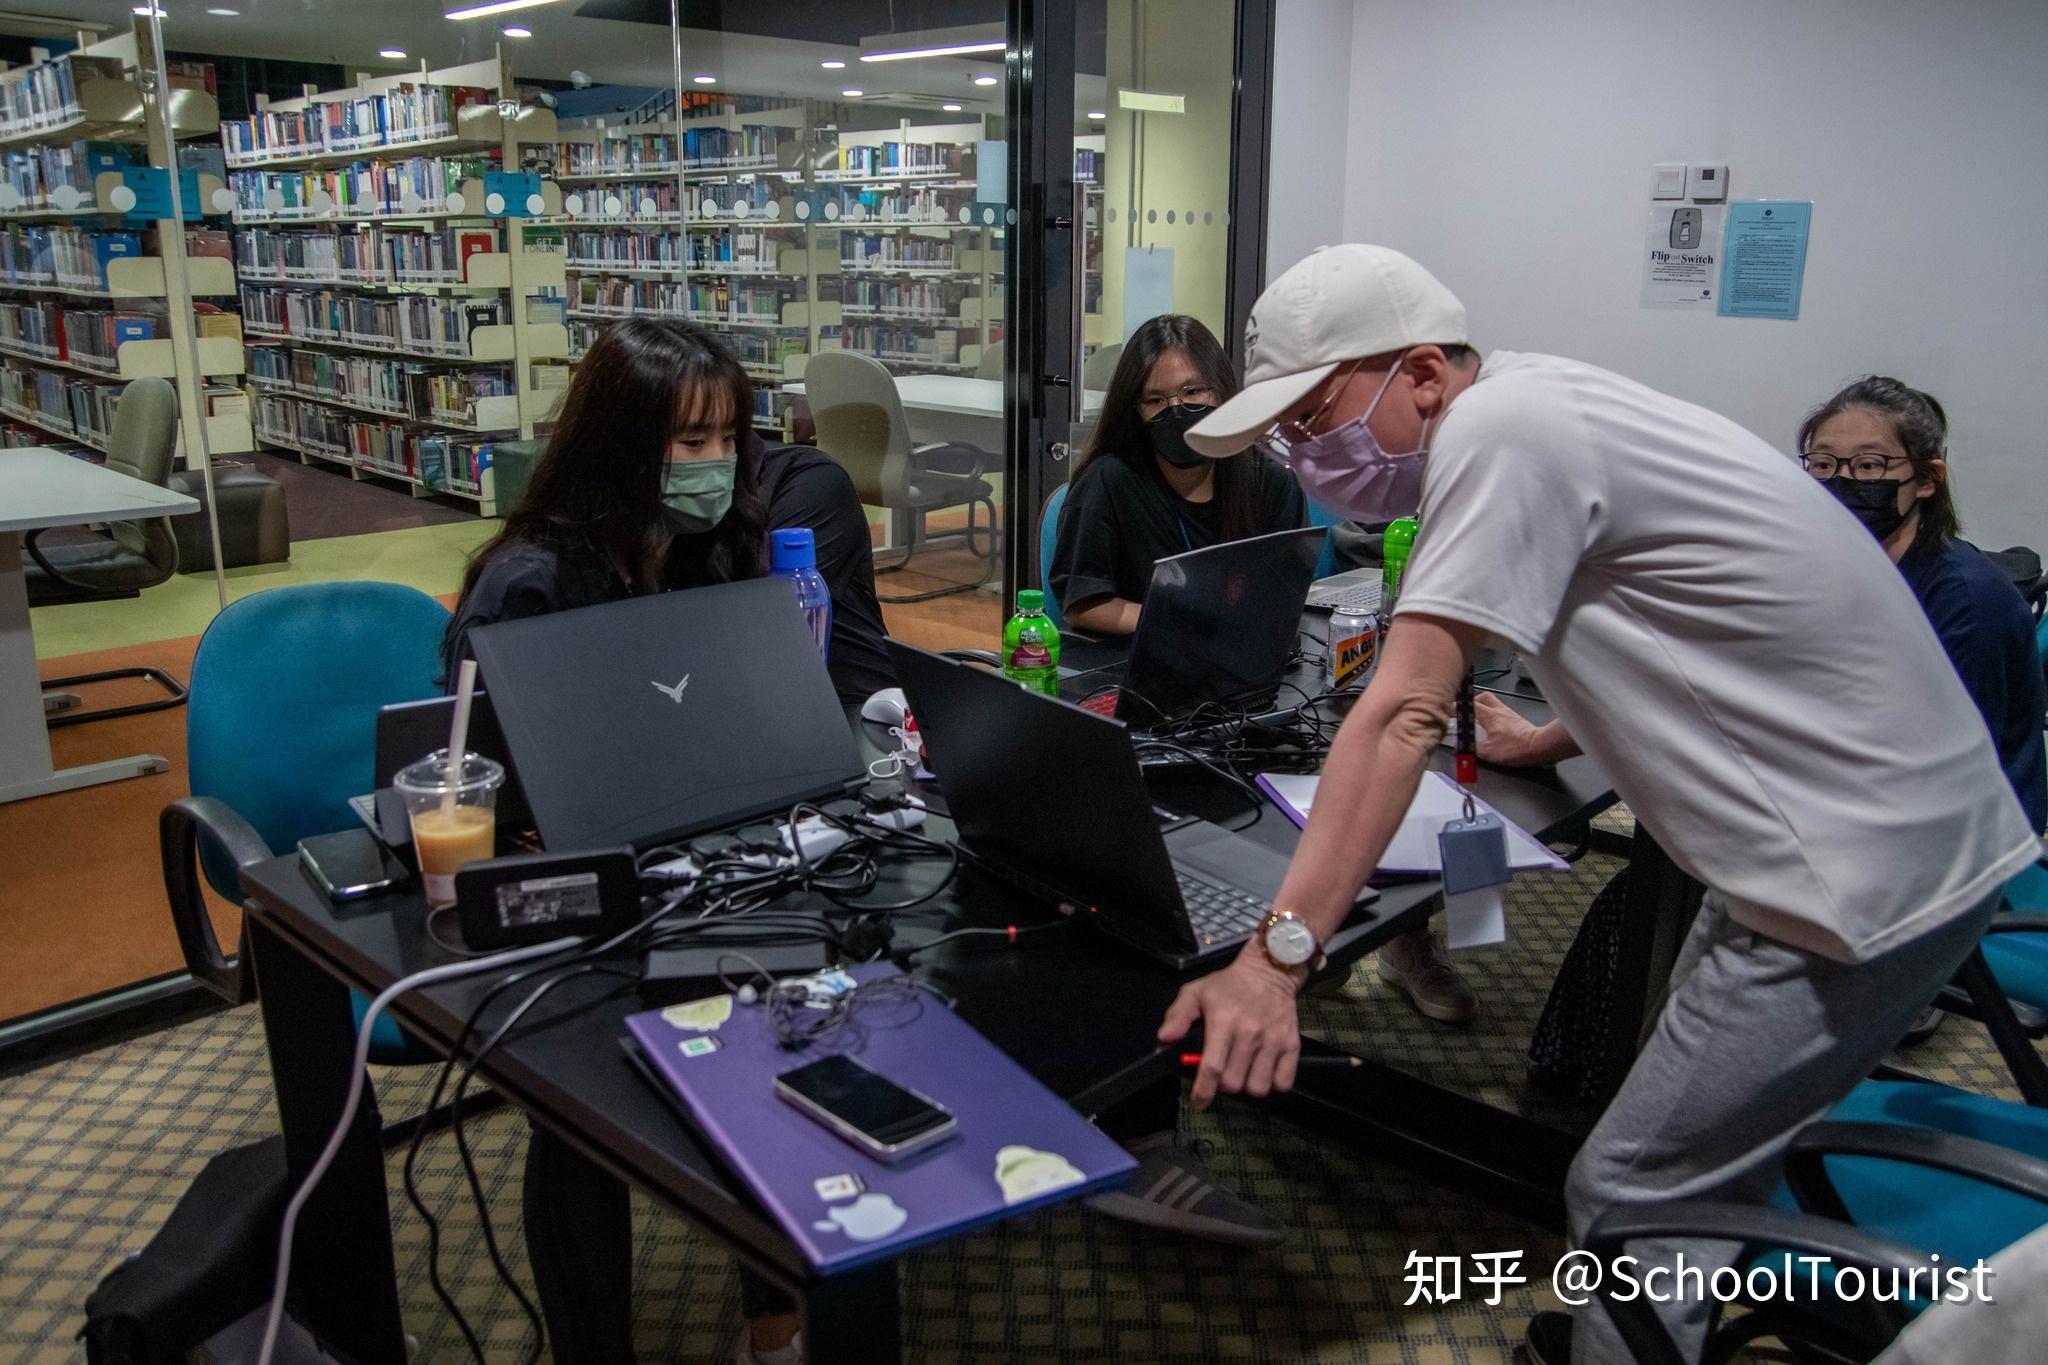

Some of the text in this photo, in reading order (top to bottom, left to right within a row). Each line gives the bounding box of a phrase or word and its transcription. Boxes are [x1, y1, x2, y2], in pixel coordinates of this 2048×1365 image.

[536, 237, 553, 246] GET
[529, 245, 560, 253] ONLINE
[1651, 251, 1670, 262] Flip
[1681, 254, 1714, 264] Switch
